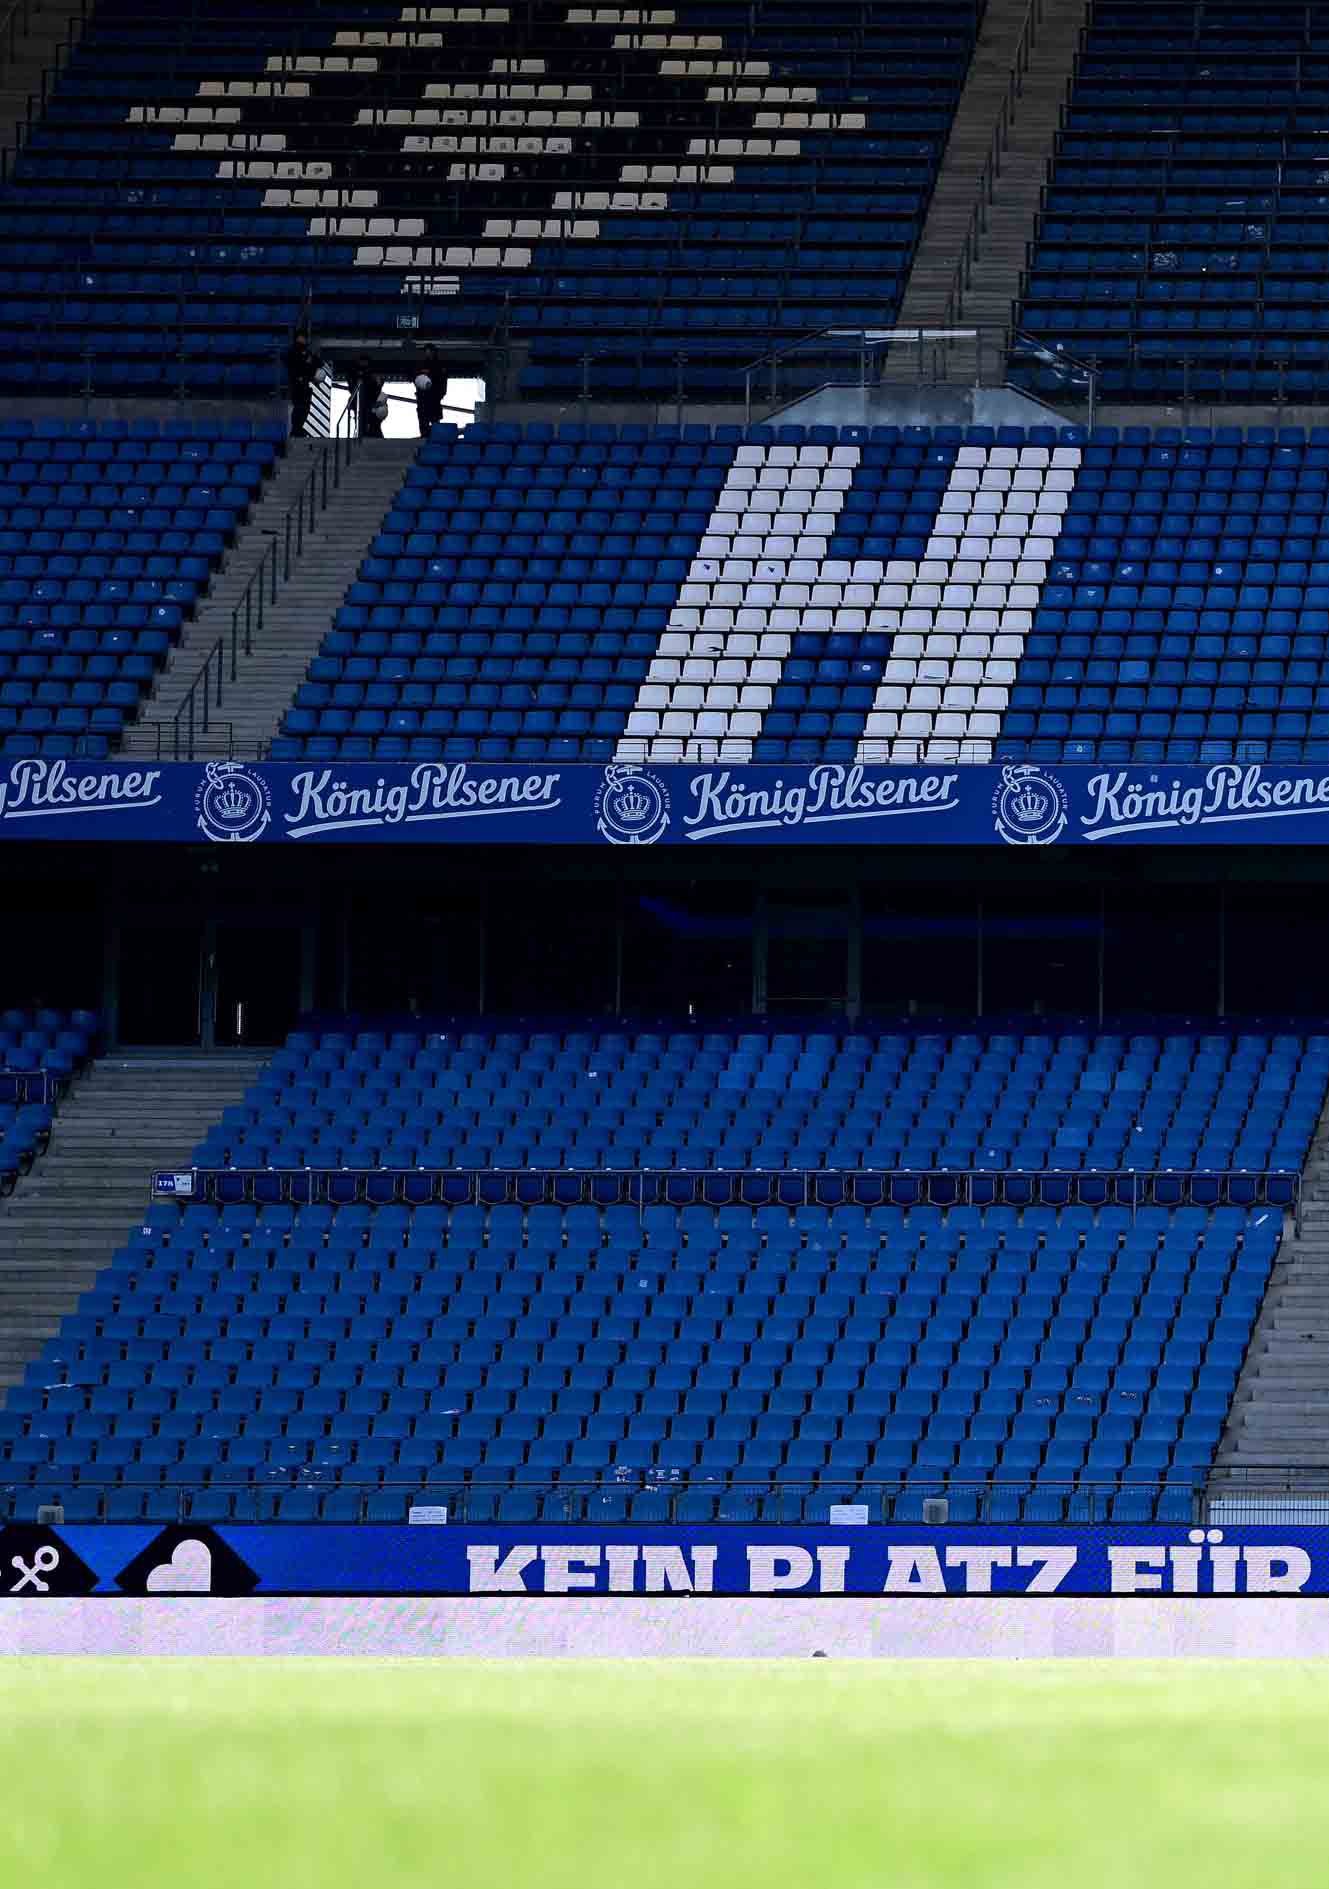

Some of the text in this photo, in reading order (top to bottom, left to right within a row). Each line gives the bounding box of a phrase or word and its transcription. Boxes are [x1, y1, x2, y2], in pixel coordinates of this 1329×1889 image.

[7, 760, 161, 808] Pilsener
[284, 763, 561, 823] König Pilsener
[683, 764, 959, 825] König Pilsener
[1080, 772, 1204, 825] König
[466, 1545, 718, 1593] KEIN
[1107, 1528, 1312, 1594] FÜR
